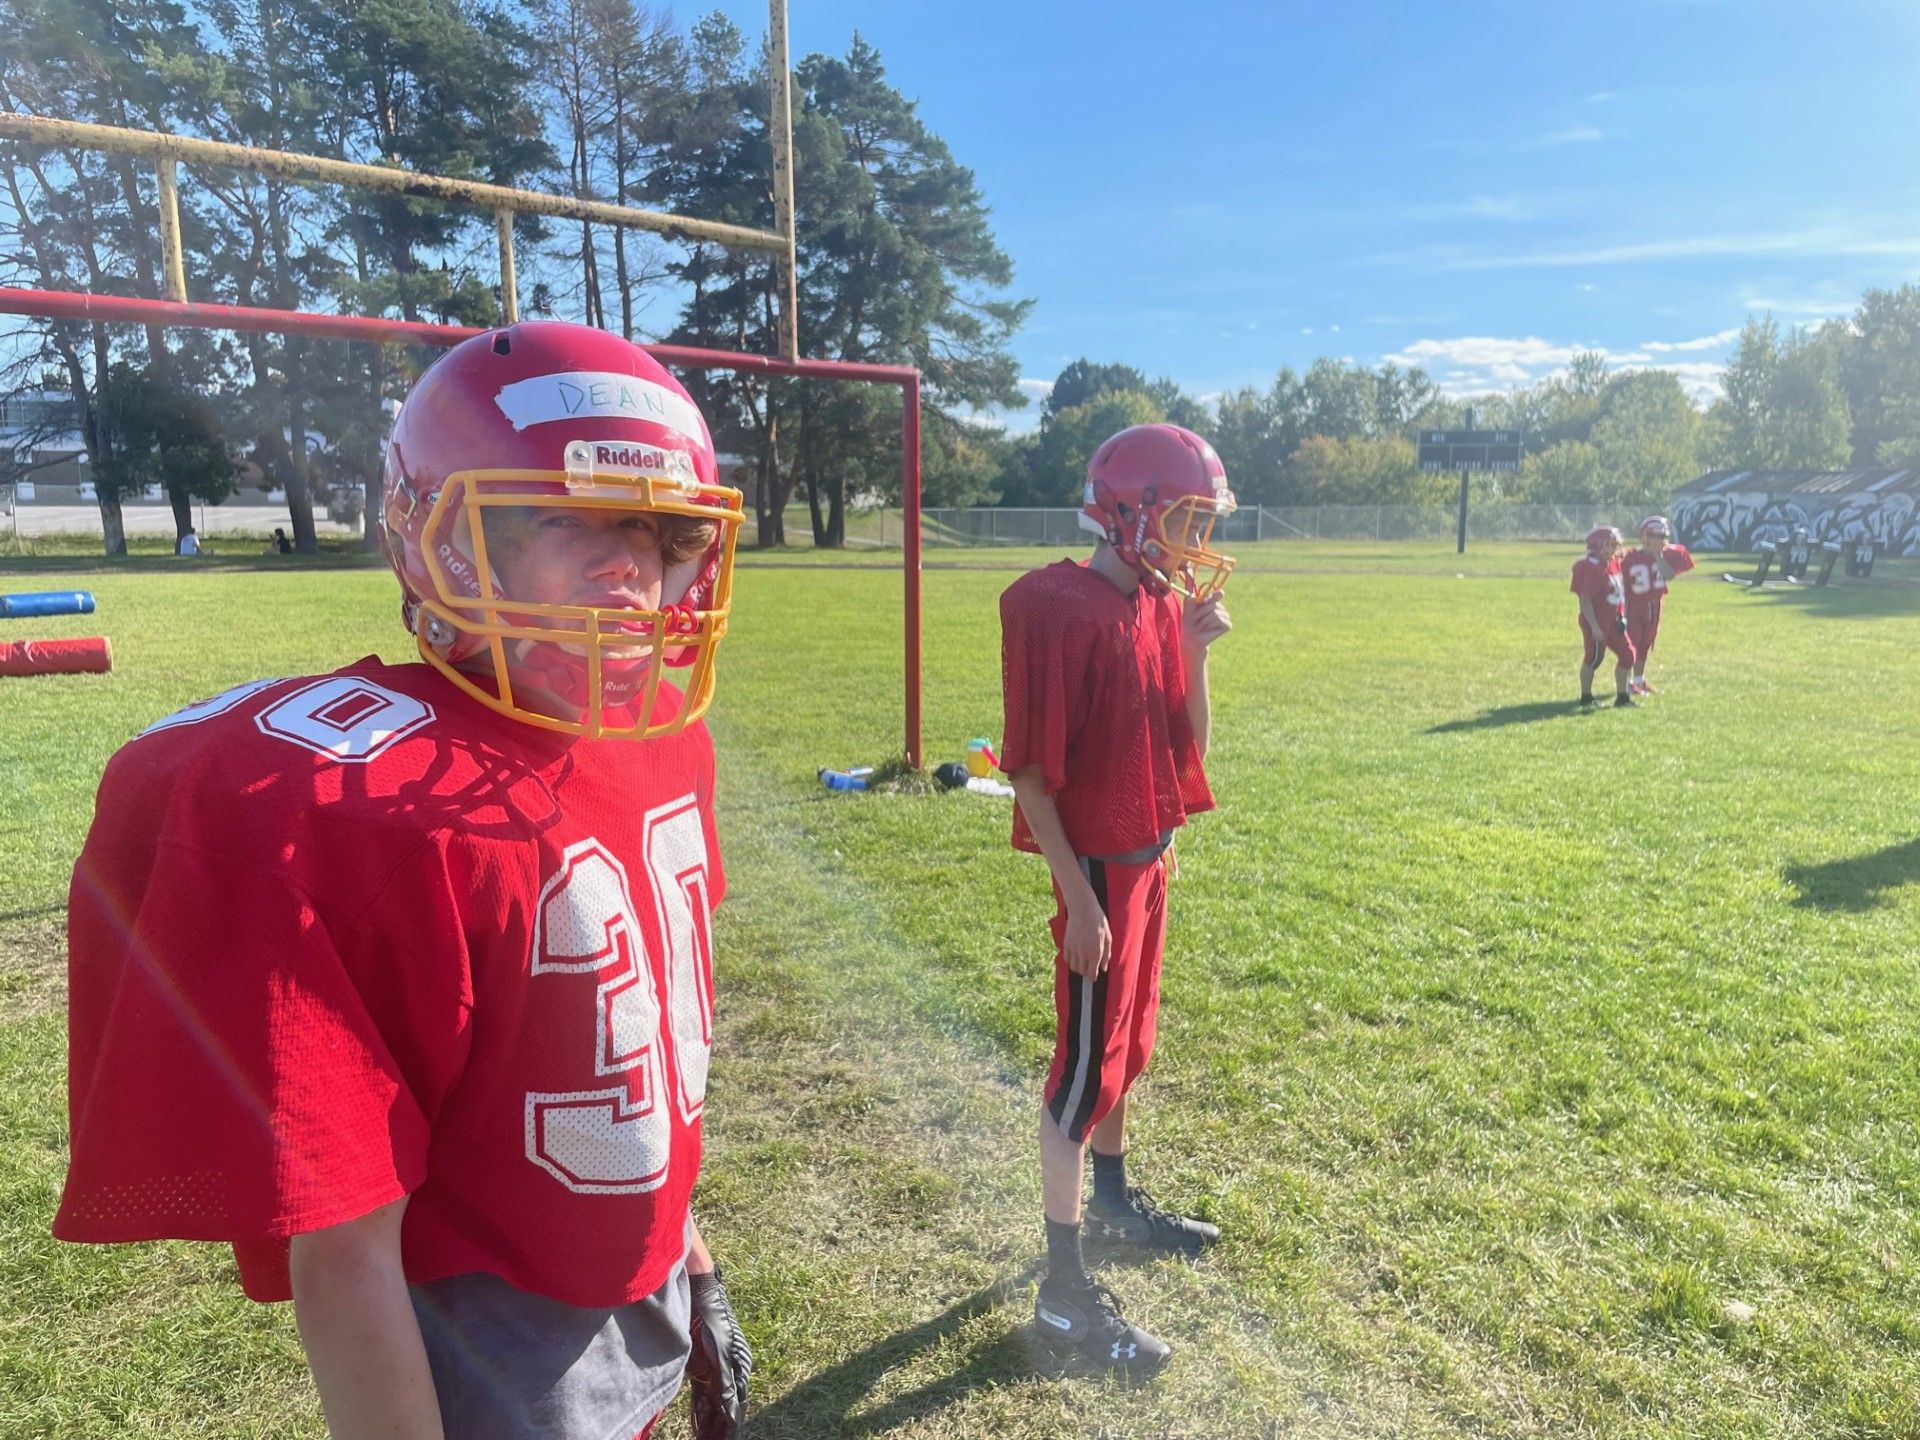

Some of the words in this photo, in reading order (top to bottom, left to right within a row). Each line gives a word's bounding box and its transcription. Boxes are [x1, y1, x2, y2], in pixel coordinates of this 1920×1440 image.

[558, 381, 665, 415] DEAN
[596, 445, 666, 470] Riddell
[524, 792, 714, 1195] 30
